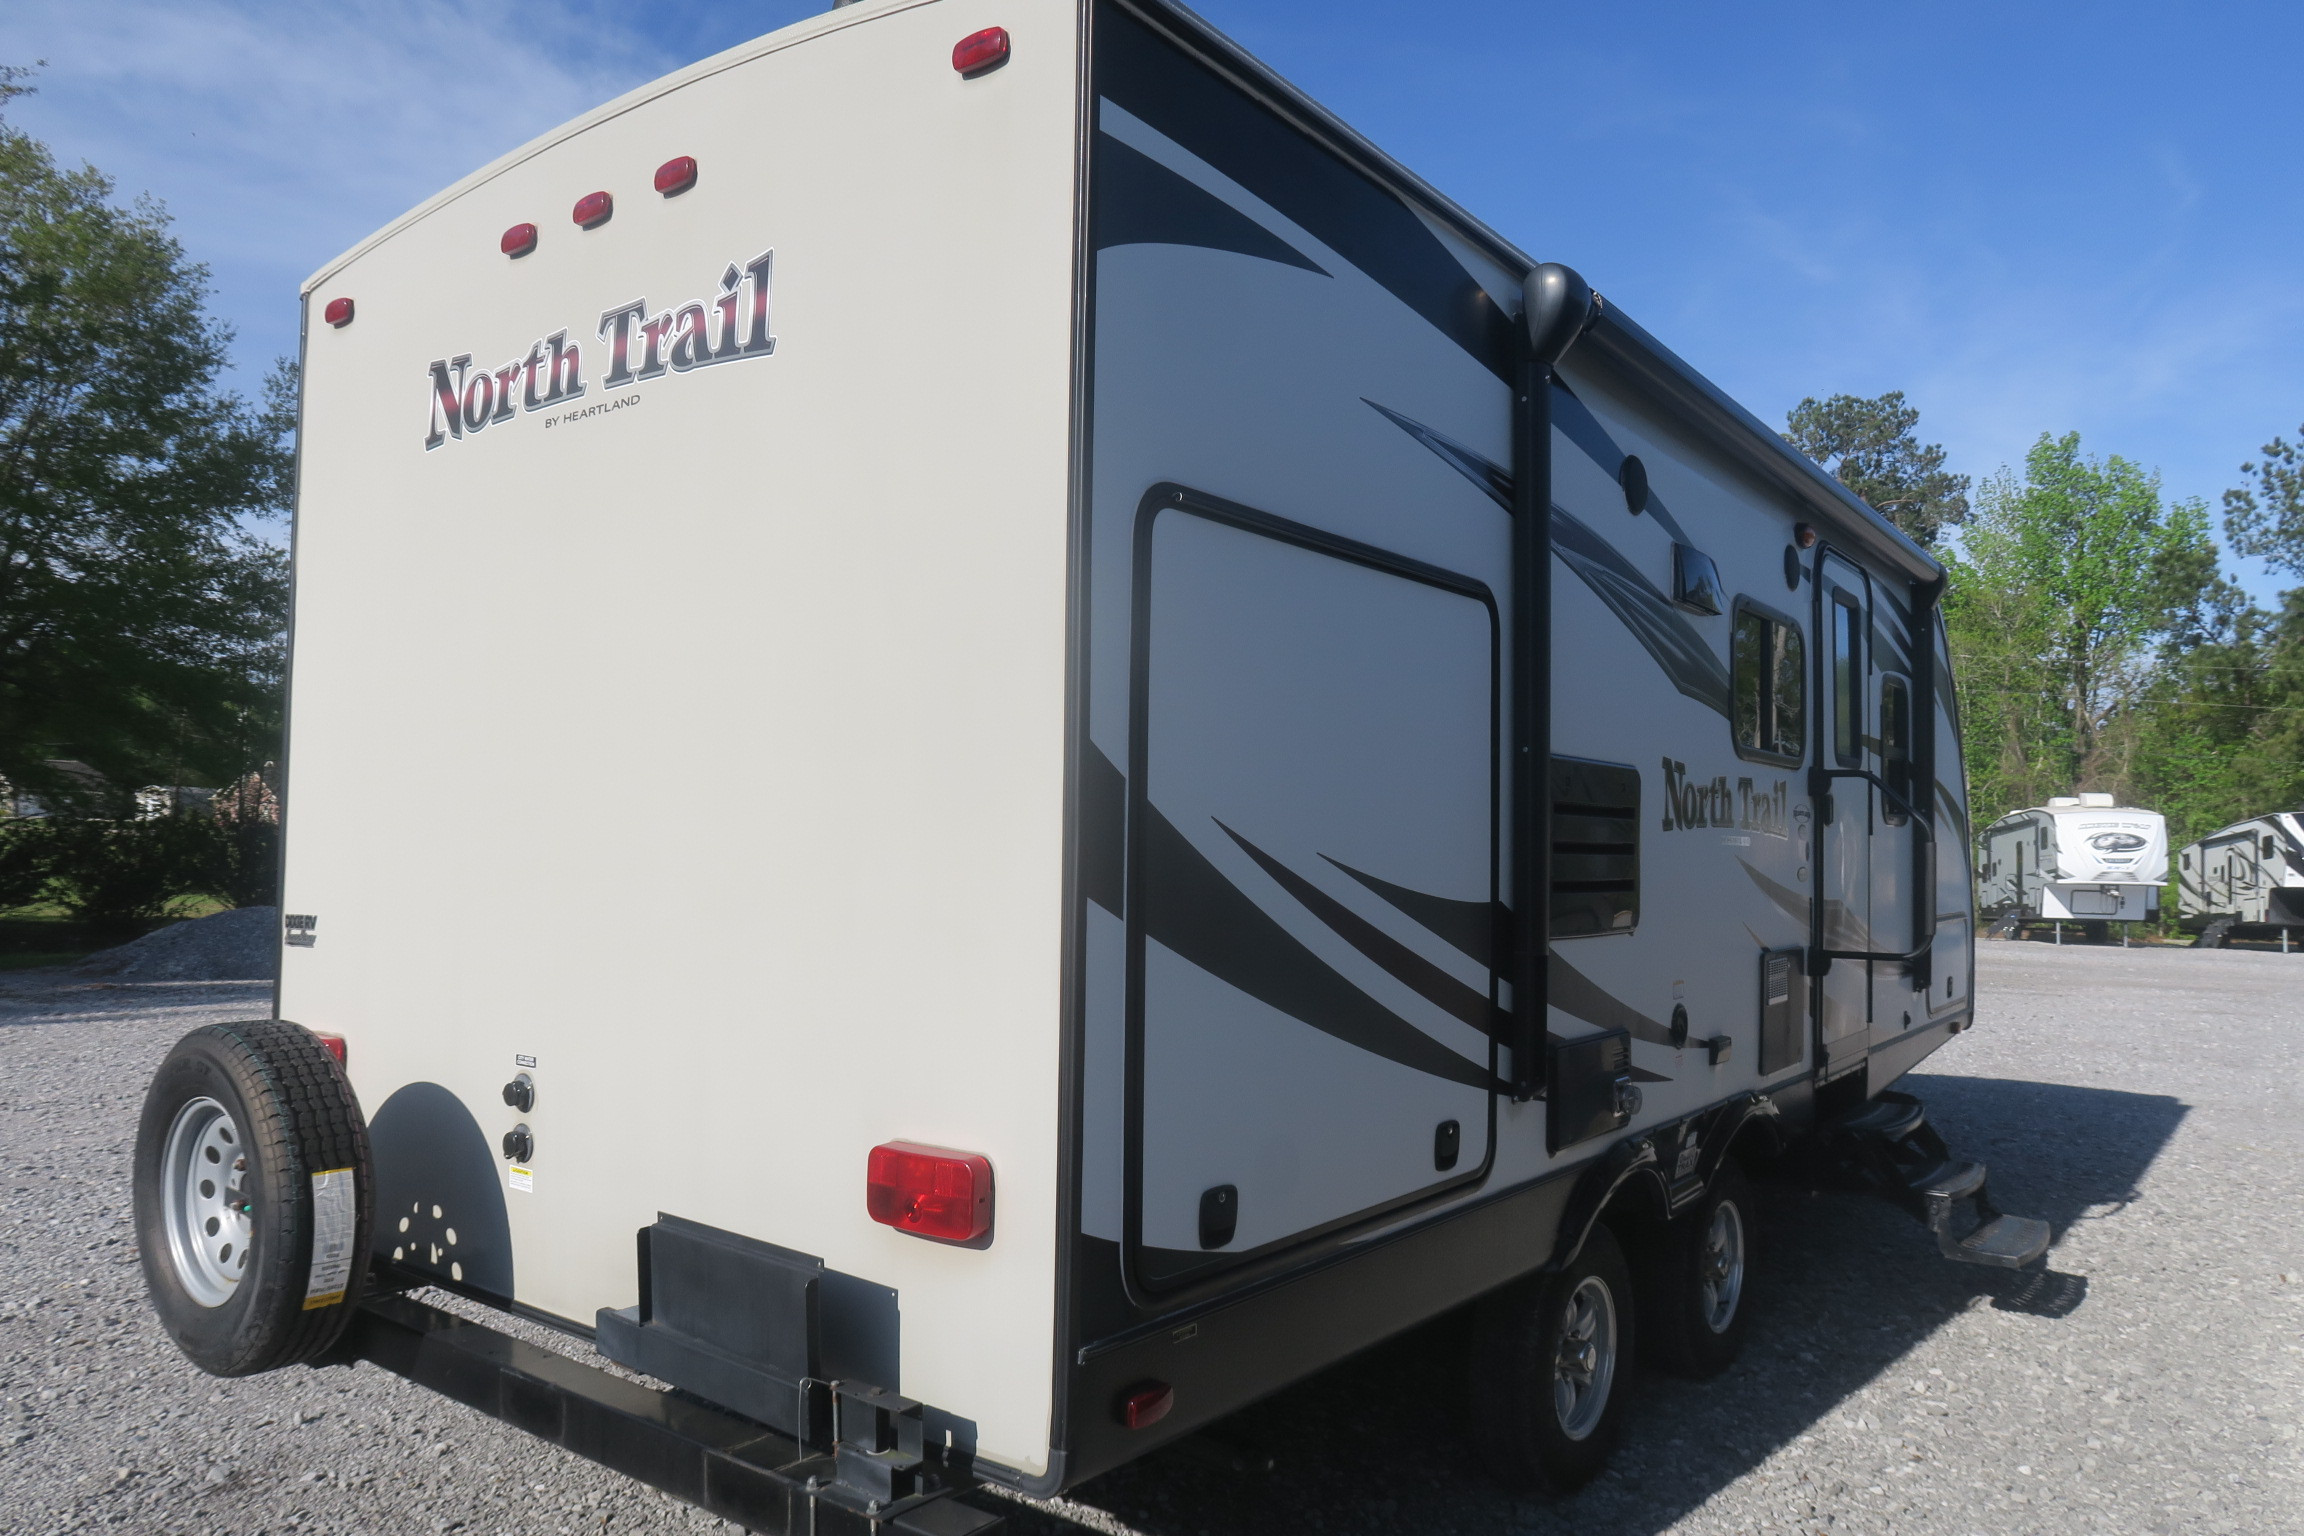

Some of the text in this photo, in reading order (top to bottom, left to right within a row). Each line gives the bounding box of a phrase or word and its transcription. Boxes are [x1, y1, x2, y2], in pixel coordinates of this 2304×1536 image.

[424, 247, 777, 452] North Trail
[545, 394, 641, 428] BY HEARTLAND
[1662, 756, 1788, 840] North Trail
